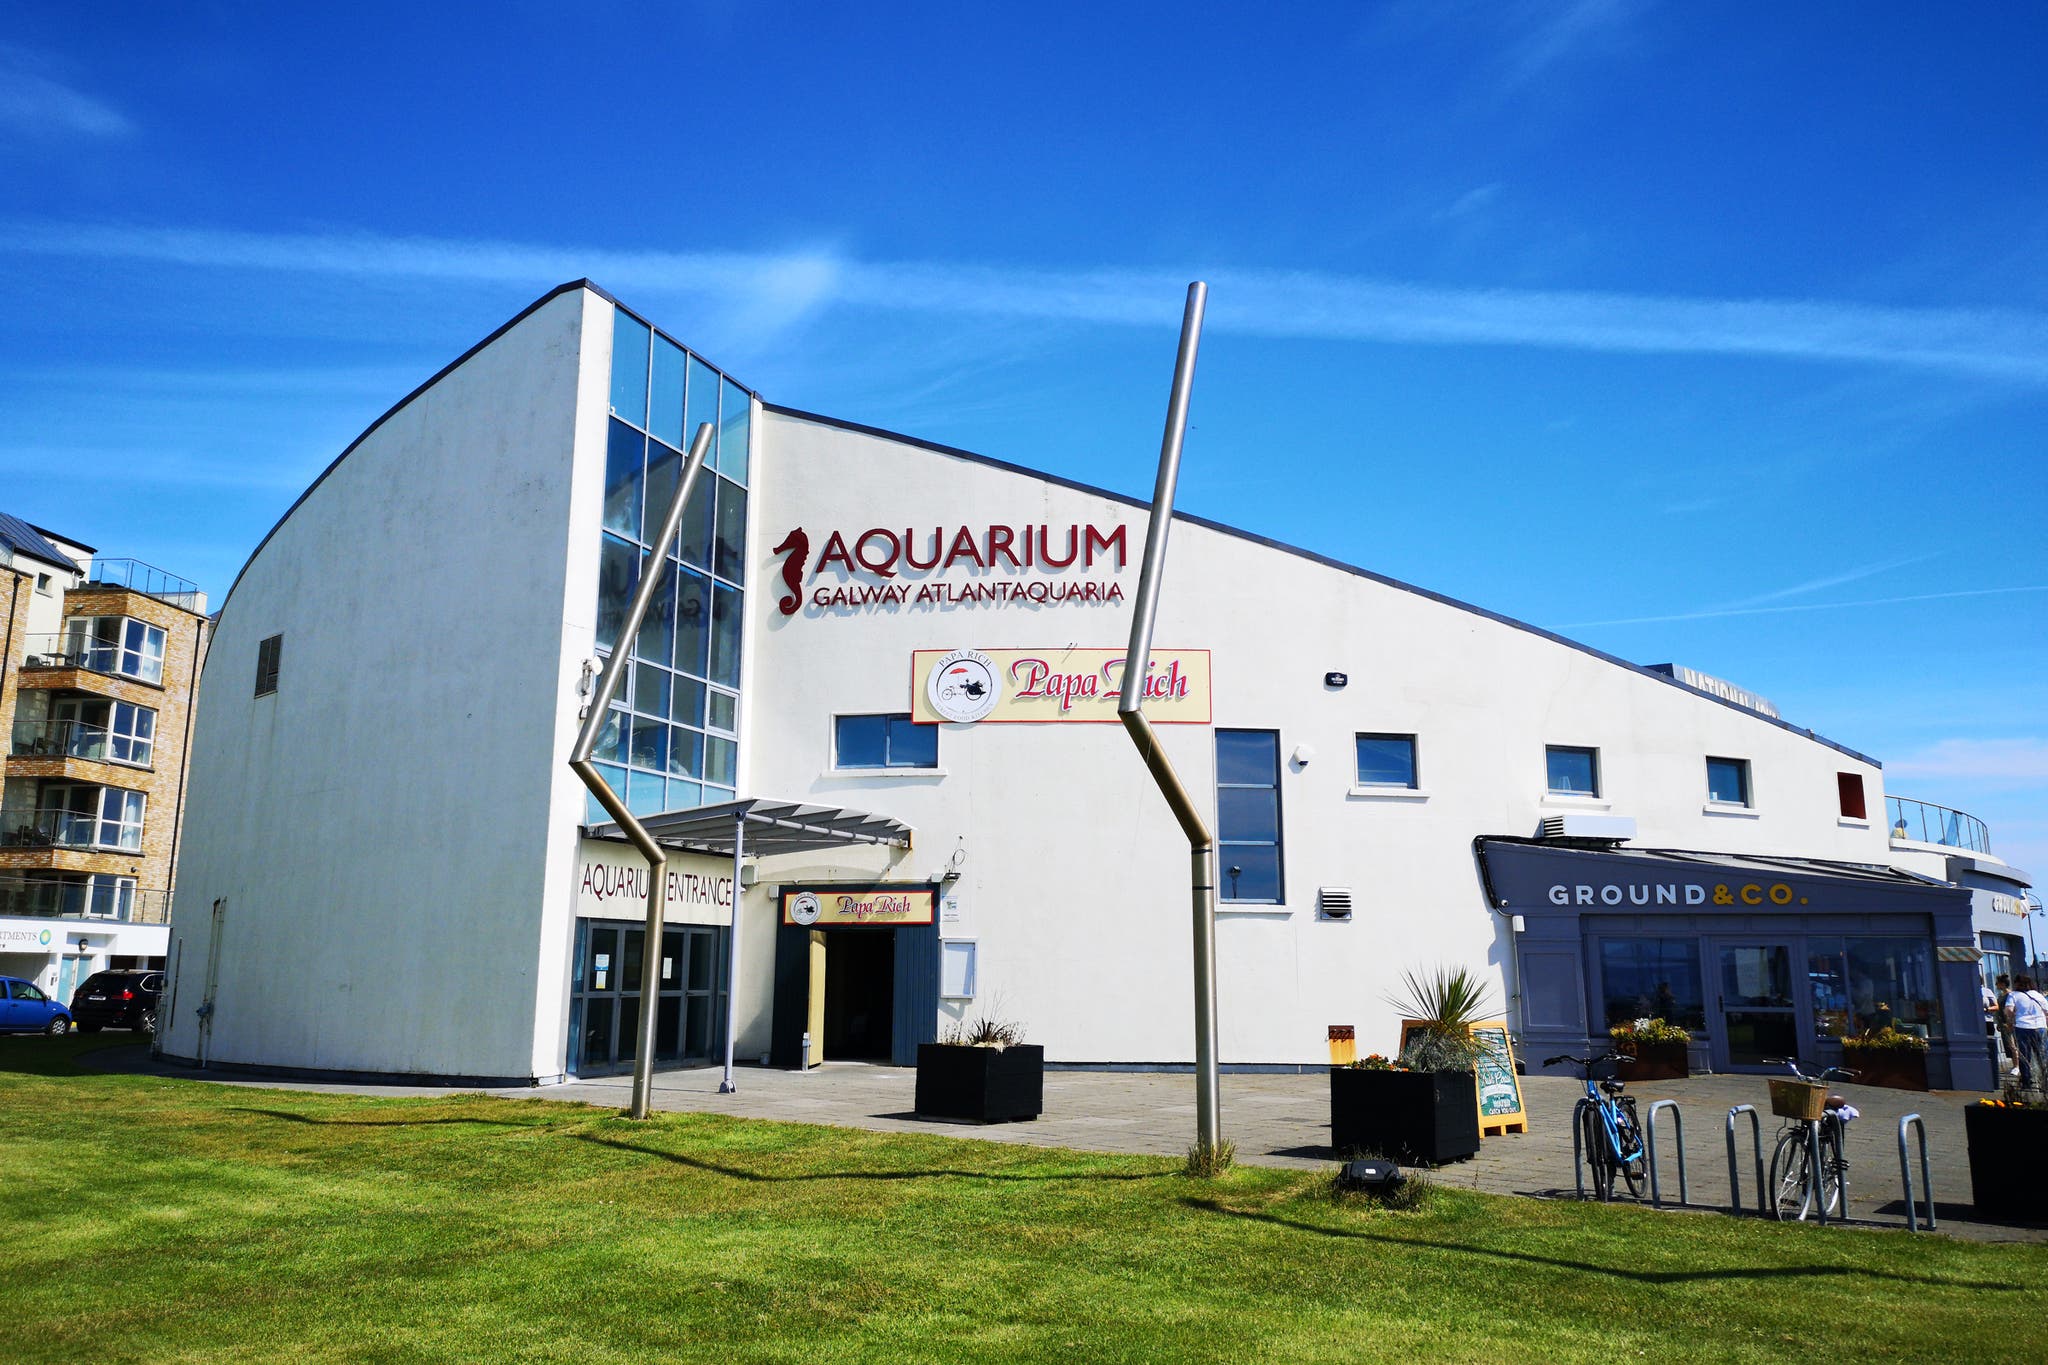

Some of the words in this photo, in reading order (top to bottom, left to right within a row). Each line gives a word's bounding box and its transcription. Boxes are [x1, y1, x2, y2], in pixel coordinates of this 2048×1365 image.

[816, 524, 1127, 577] AQUARIUM
[813, 583, 912, 606] GALWAY
[916, 581, 1125, 604] ATLANTAQUARIA
[939, 651, 964, 667] PAPA
[967, 650, 992, 667] RICH
[1011, 658, 1099, 711] Papa
[581, 862, 650, 901] AQUARIU
[667, 872, 732, 906] ENTRANCE
[836, 895, 873, 919] Papa
[875, 895, 911, 914] Rich
